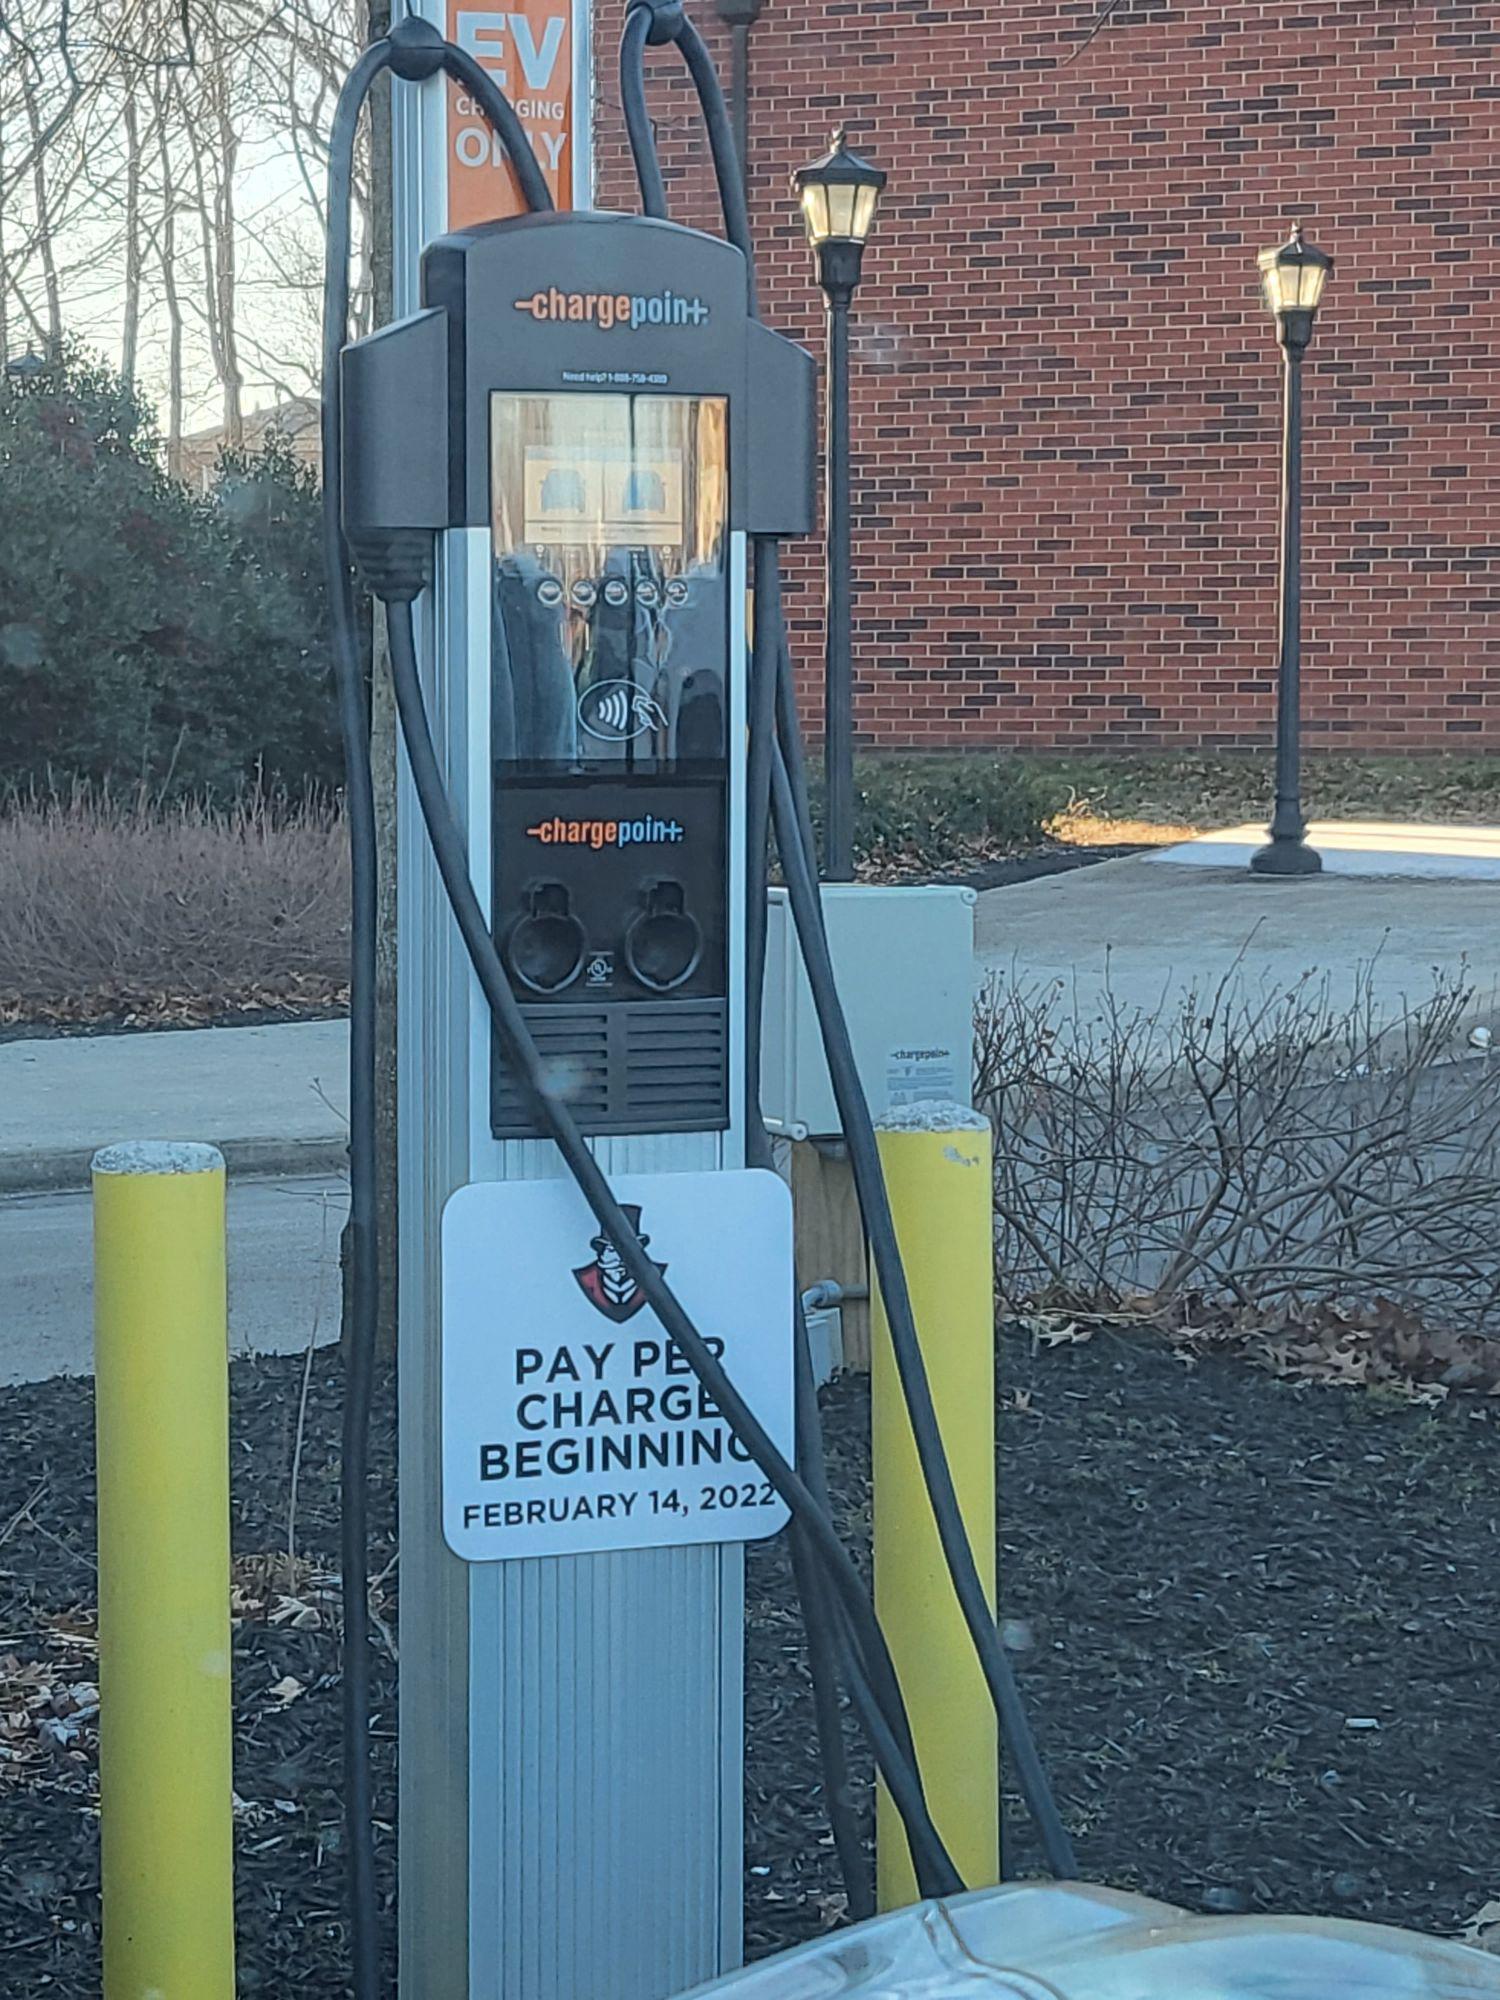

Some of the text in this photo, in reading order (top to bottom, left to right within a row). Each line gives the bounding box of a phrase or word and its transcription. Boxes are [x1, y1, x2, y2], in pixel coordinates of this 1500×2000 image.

[456, 11, 566, 90] EV
[456, 96, 565, 120] CHGING
[456, 127, 568, 170] ONY
[515, 1343, 615, 1385] PAY
[517, 1384, 724, 1430] CHARGE
[464, 1483, 776, 1529] FEBRUARY 14, 2022
